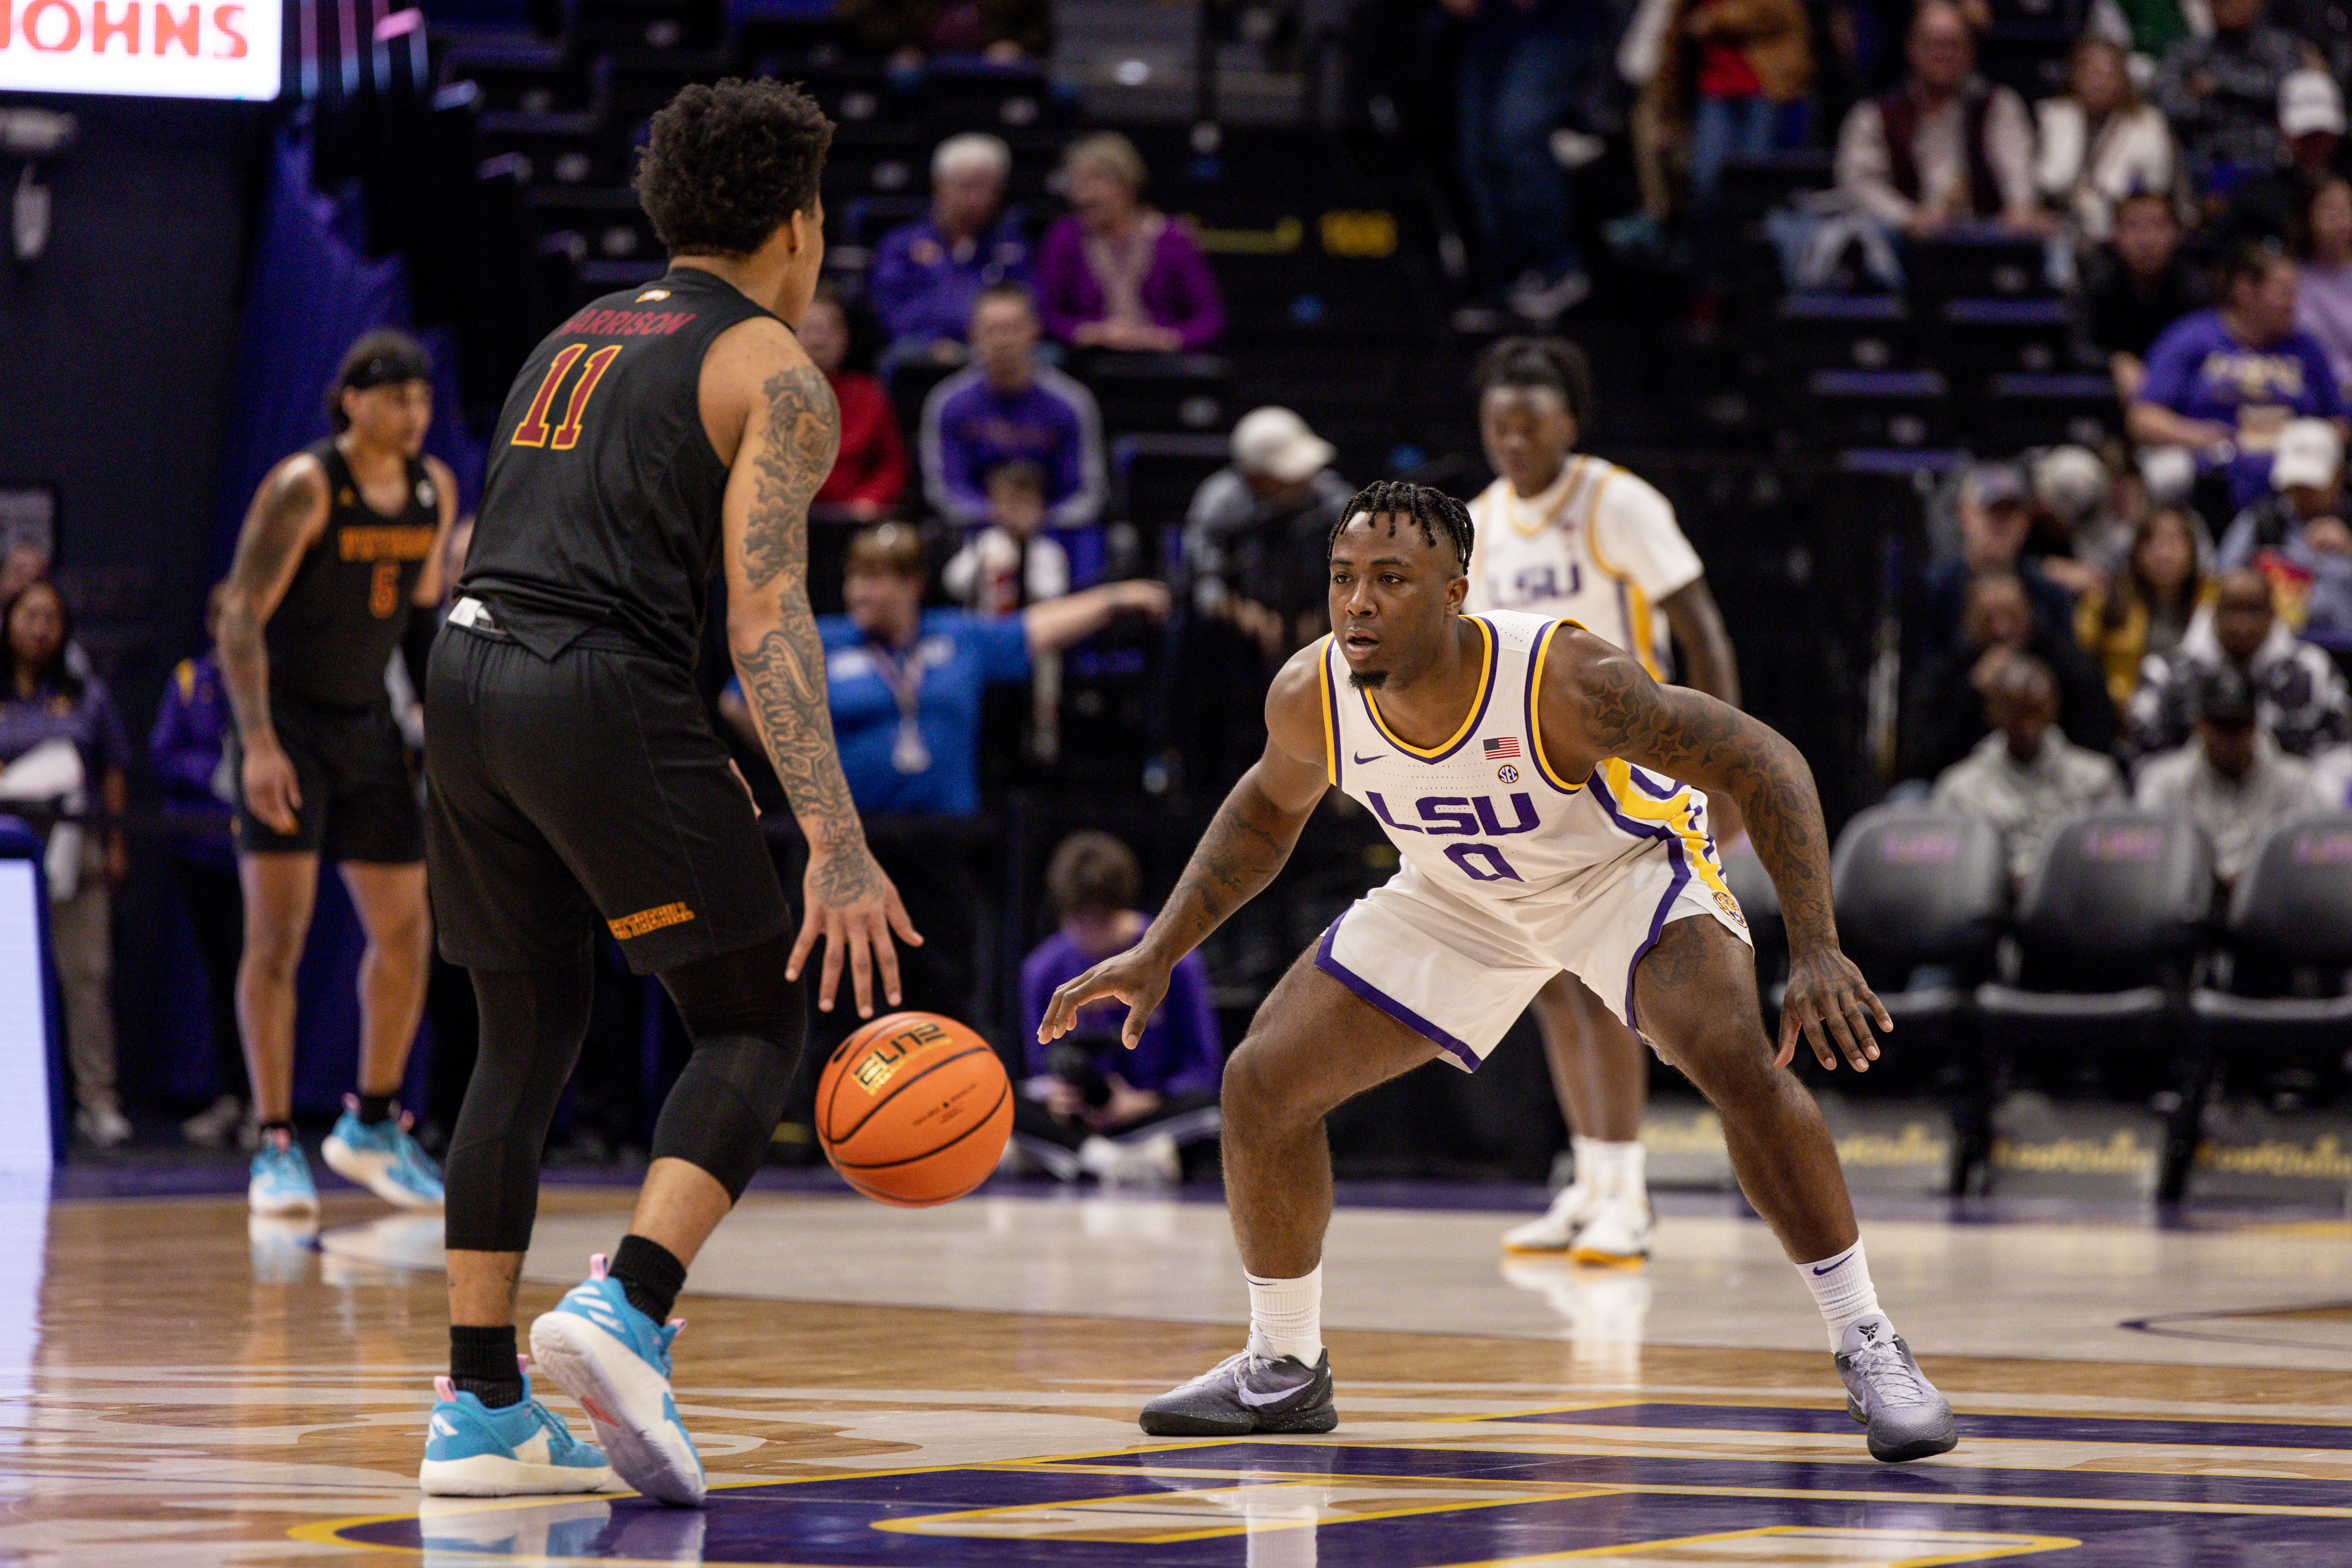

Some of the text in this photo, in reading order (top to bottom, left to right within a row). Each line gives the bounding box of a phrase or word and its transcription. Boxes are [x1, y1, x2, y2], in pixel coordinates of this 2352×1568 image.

[510, 343, 623, 450] 11
[1498, 766, 1518, 783] SEC
[1365, 790, 1541, 836] LSU
[1442, 843, 1525, 882] 0
